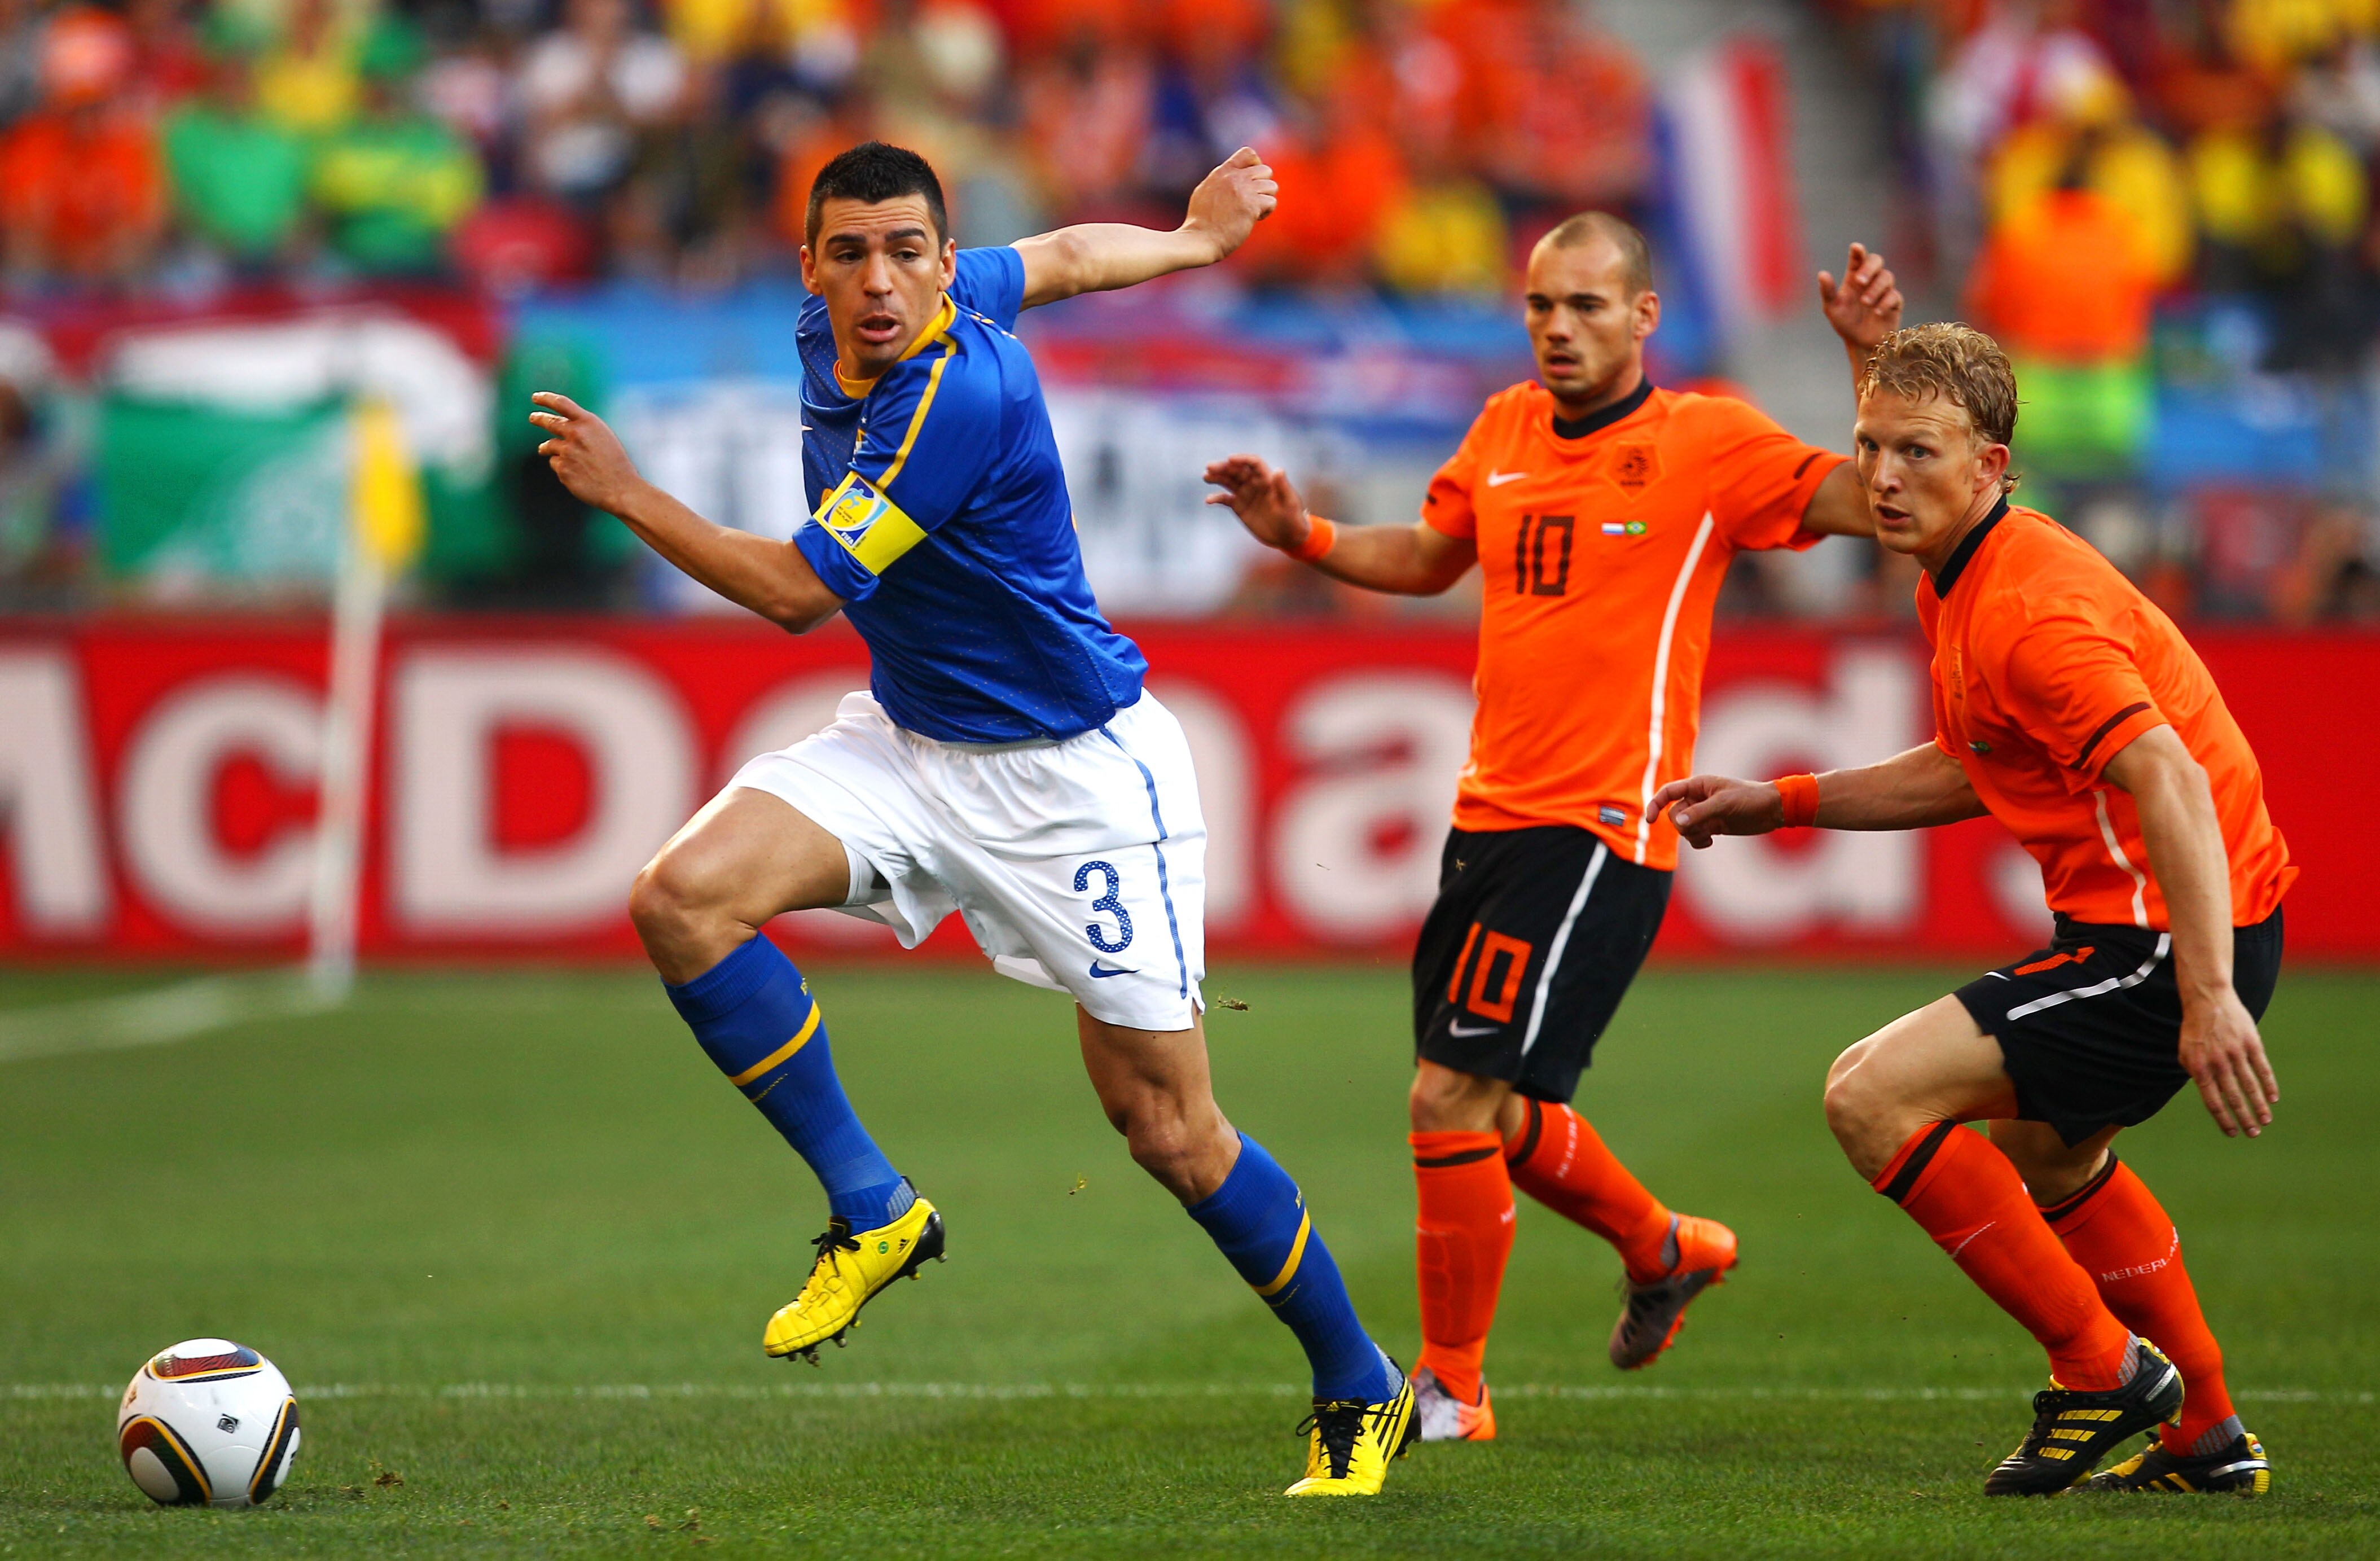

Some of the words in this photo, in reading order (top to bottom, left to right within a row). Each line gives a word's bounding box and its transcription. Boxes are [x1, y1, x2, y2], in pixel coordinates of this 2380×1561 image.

[841, 532, 854, 545] FIFA
[1515, 514, 1575, 597] 10
[1074, 861, 1133, 953] 3
[1447, 921, 1533, 1024] 10
